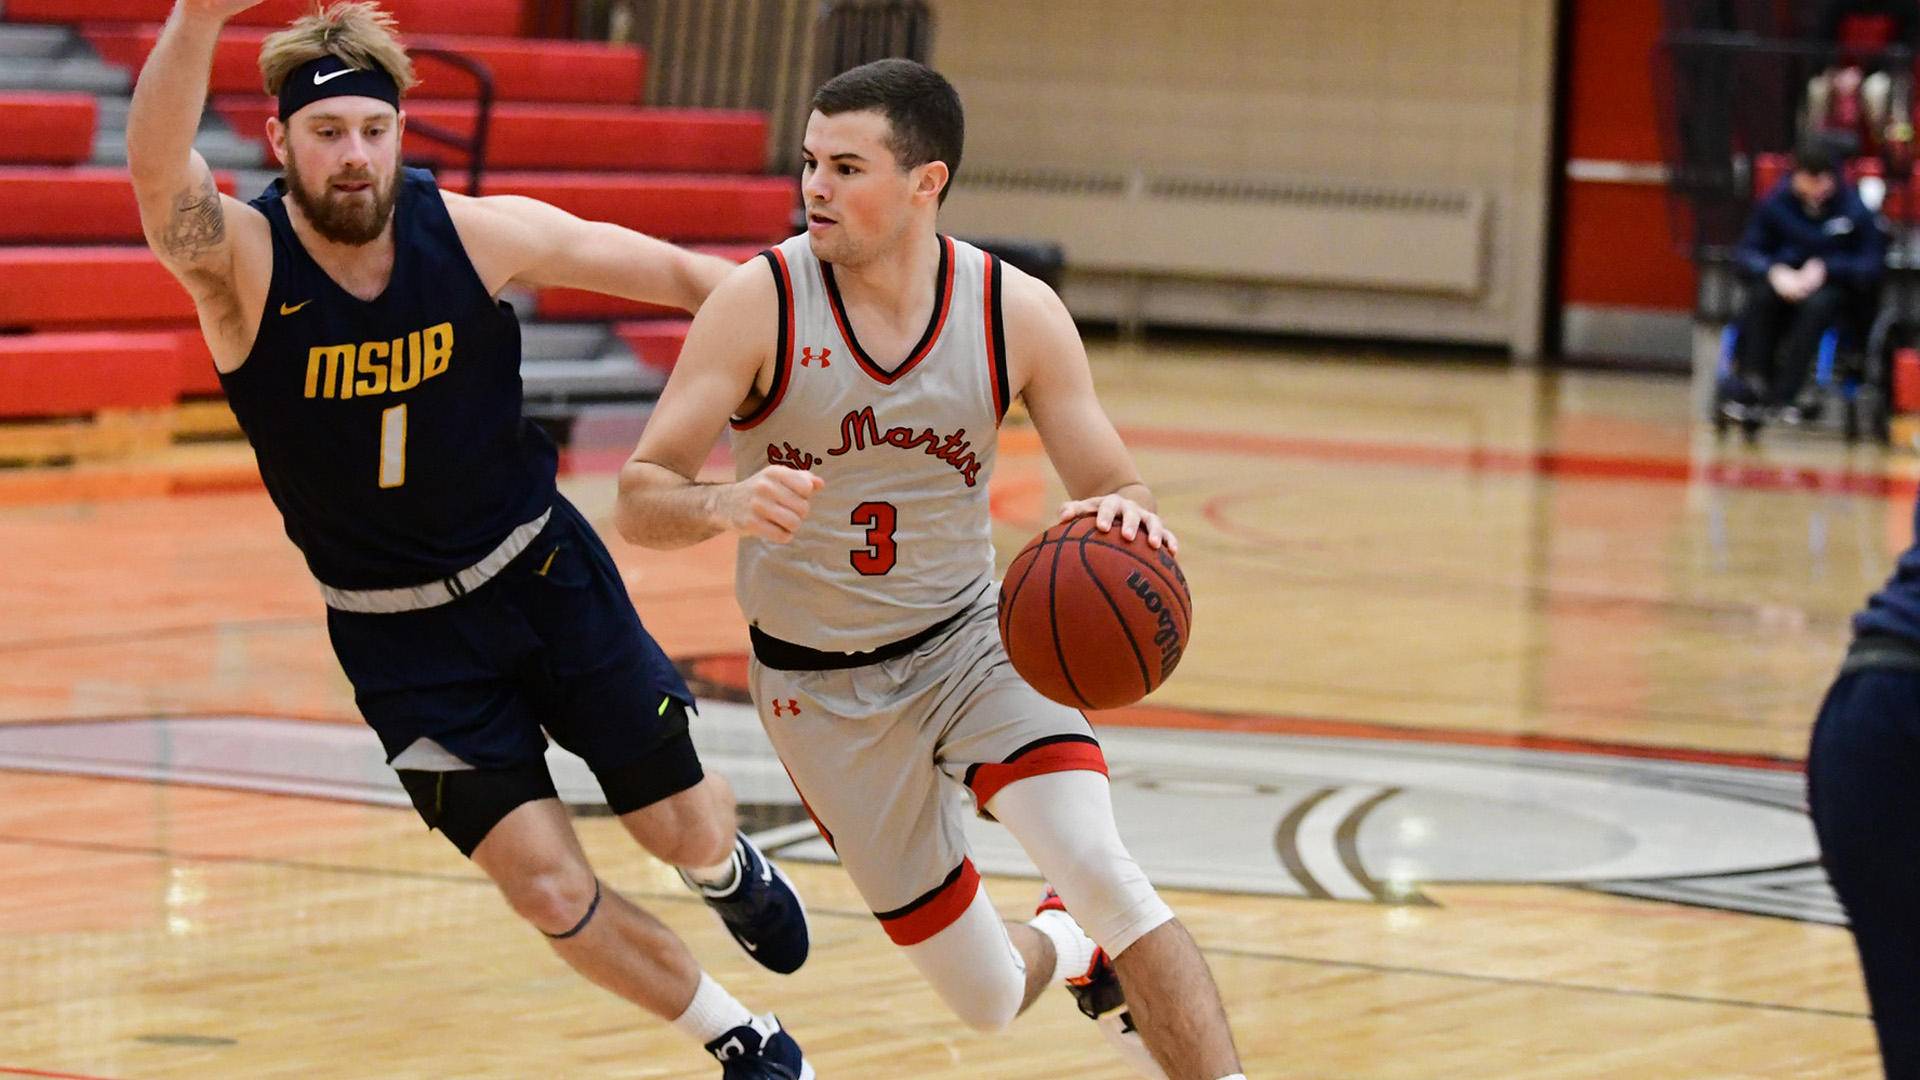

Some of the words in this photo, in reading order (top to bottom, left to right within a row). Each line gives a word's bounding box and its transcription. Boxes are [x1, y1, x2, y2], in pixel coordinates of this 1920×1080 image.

[304, 321, 454, 399] MSUB
[378, 403, 407, 489] 1
[850, 501, 897, 576] 3
